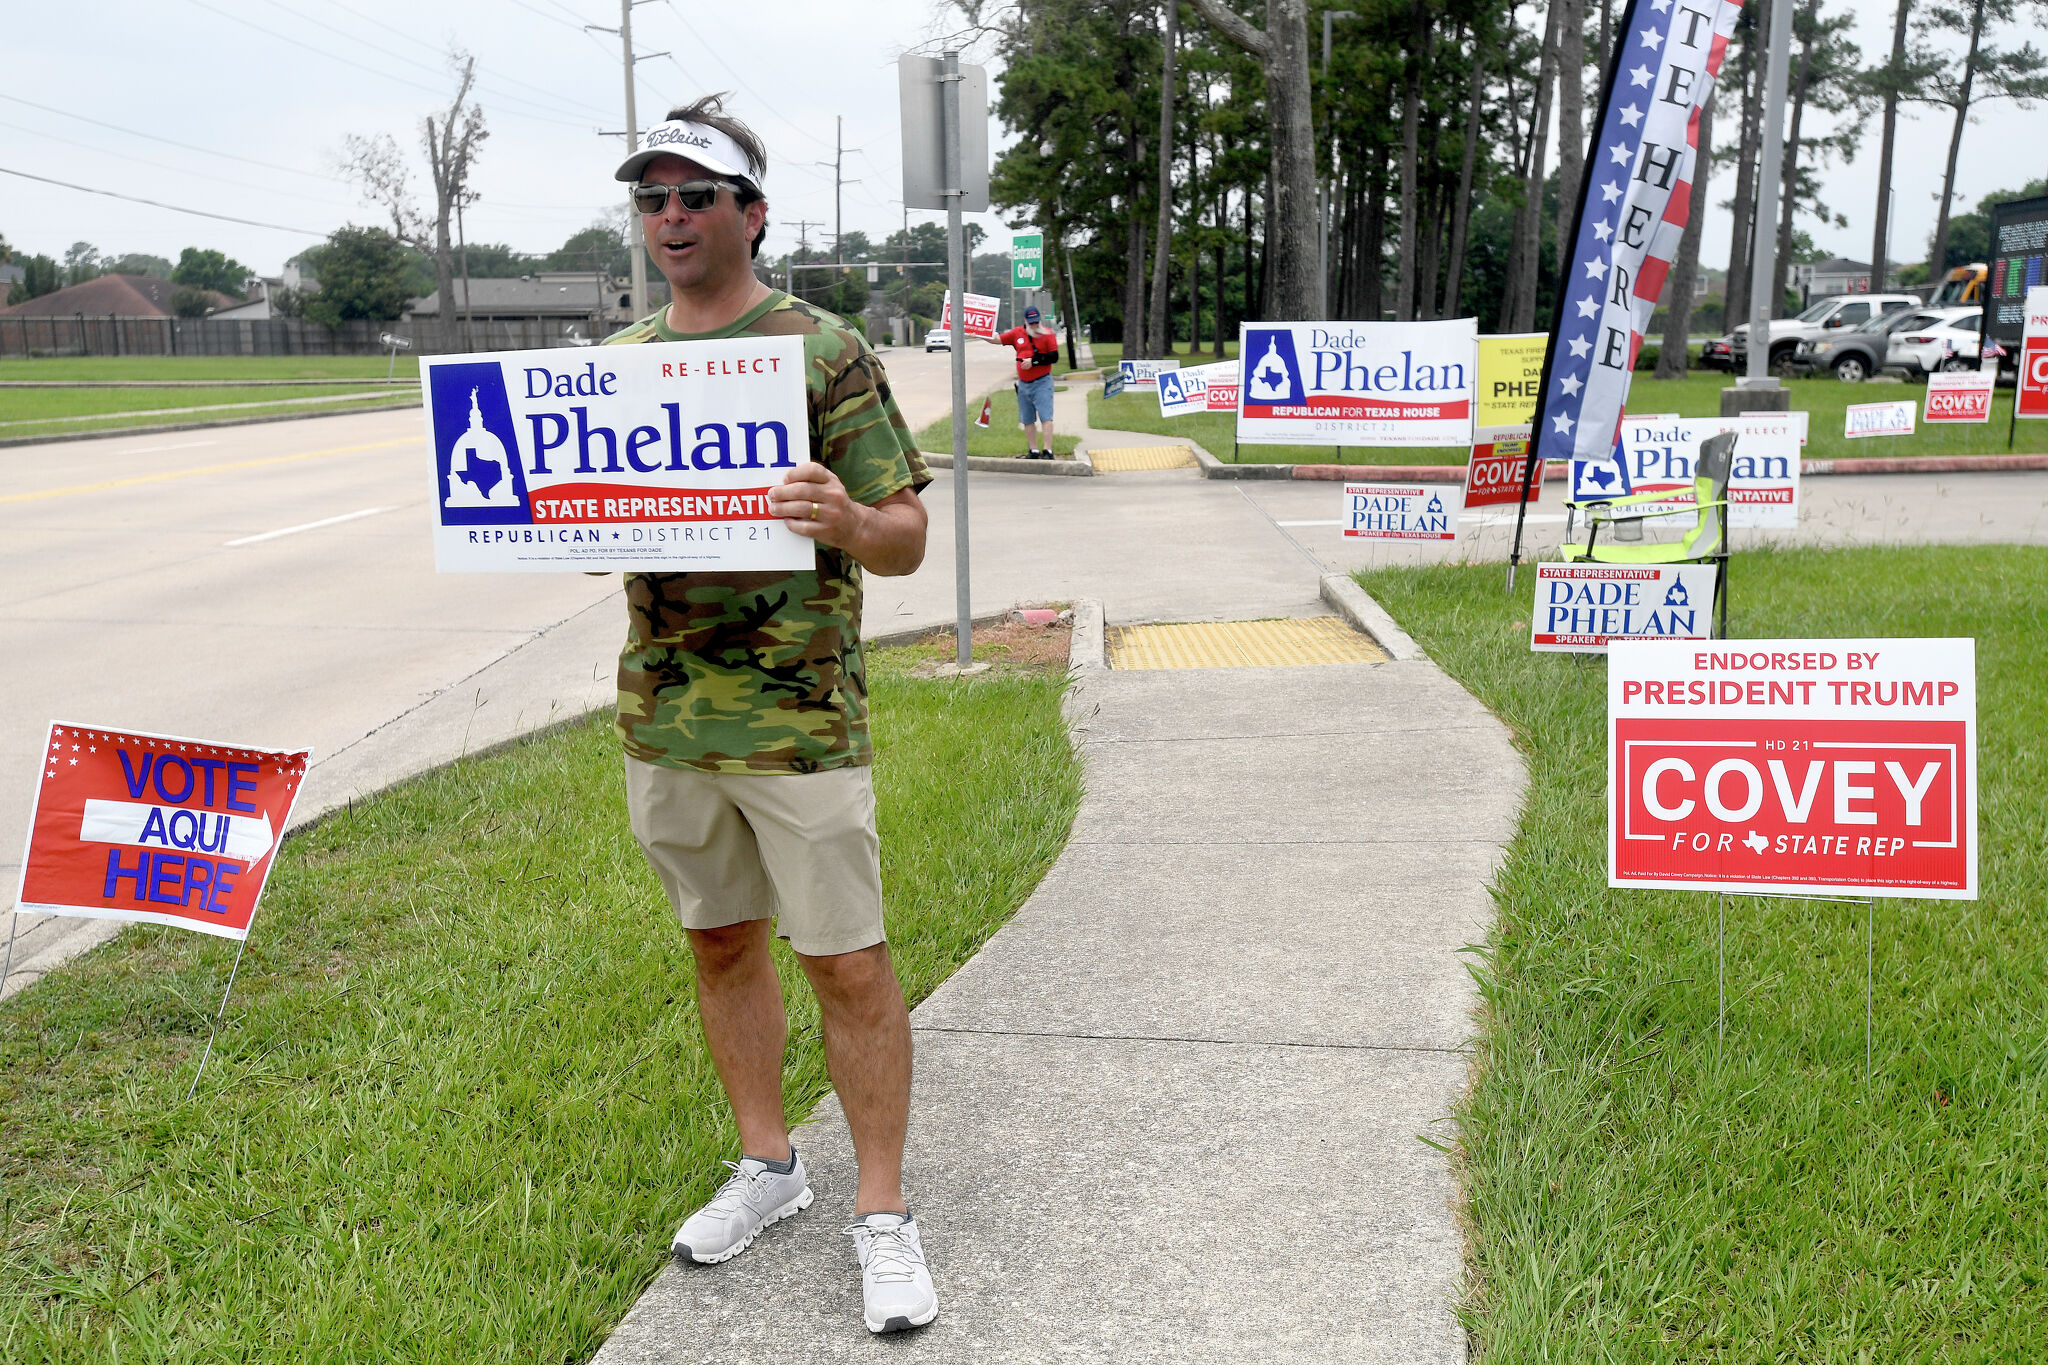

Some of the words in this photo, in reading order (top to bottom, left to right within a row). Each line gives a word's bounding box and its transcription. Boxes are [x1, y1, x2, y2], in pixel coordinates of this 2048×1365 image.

[646, 125, 713, 149] Titleist
[1013, 245, 1041, 260] Entrance
[1598, 141, 1683, 371] HERE
[1017, 263, 1037, 281] Only
[1312, 329, 1366, 348] Dade
[662, 358, 781, 377] RE-ELECT
[1310, 350, 1466, 392] Phelan
[1523, 368, 1541, 376] DA
[523, 362, 617, 399] Dade
[1494, 381, 1538, 397] PHE
[1272, 406, 1340, 417] REPUBLICAN
[1342, 407, 1363, 417] FOR
[1365, 407, 1400, 417] TEXAS
[1402, 407, 1440, 417] HOUSE
[1931, 395, 1985, 410] COVEY
[1315, 423, 1377, 431] DISTRICT
[1382, 423, 1395, 431] 21
[1634, 426, 1692, 443] Dade
[525, 402, 797, 475] Phelan
[1633, 447, 1791, 480] Phan
[535, 498, 599, 519] STATE
[1353, 495, 1412, 512] DADE
[1352, 512, 1447, 532] PHELAN
[469, 529, 600, 543] REPUBLICAN
[632, 526, 733, 542] DISTRICT
[749, 526, 771, 541] 21
[1543, 568, 1571, 578] STATE
[1573, 569, 1655, 579] REPRESENTATIVE
[1550, 581, 1641, 606] DADE
[1547, 606, 1696, 635] PHELAN
[1555, 635, 1596, 644] SPEAKER
[1694, 652, 1838, 670] ENDORSED
[1846, 652, 1880, 670] BY
[1622, 680, 1816, 705] PRESIDENT
[1828, 681, 1959, 706] TRUMP
[1765, 740, 1786, 750] HD
[1792, 740, 1810, 751] 21
[116, 748, 260, 813] VOTE
[1642, 757, 1942, 826] COVEY
[138, 806, 231, 854] AQUI
[1672, 832, 1734, 852] FOR
[1774, 834, 1848, 855] STATE
[1856, 836, 1905, 856] REP
[103, 848, 241, 915] HERE
